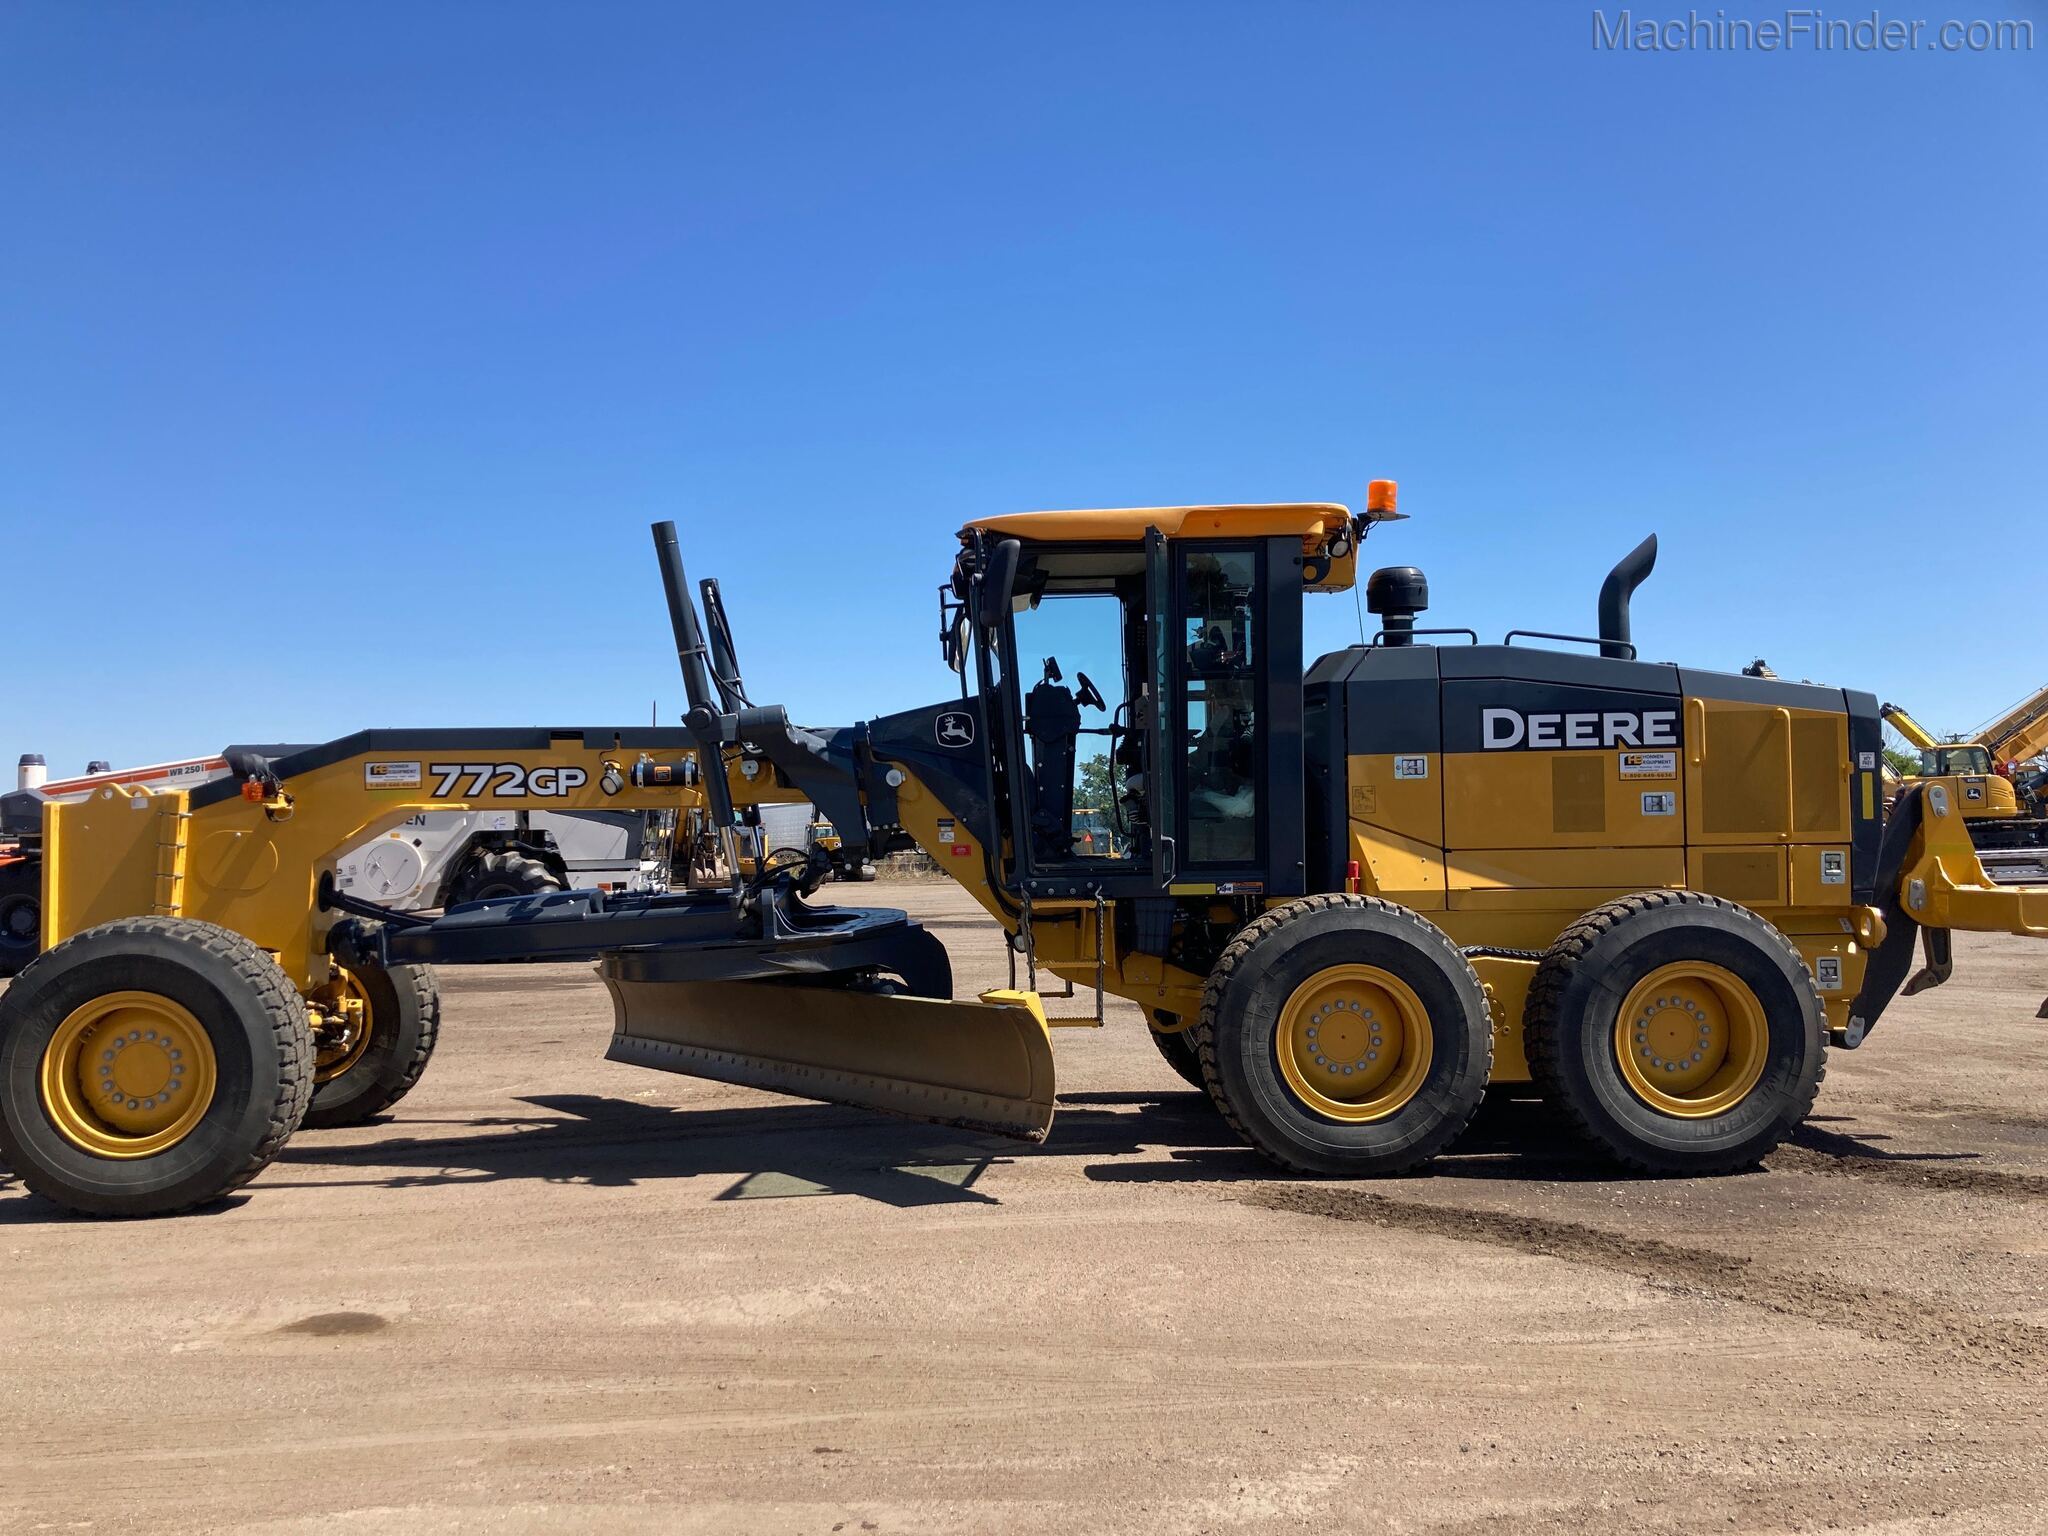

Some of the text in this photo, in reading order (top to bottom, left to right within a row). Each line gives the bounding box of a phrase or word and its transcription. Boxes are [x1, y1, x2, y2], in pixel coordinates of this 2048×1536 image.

[1482, 708, 1677, 749] DEERE
[170, 768, 183, 776] WR
[429, 762, 588, 798] 772GP
